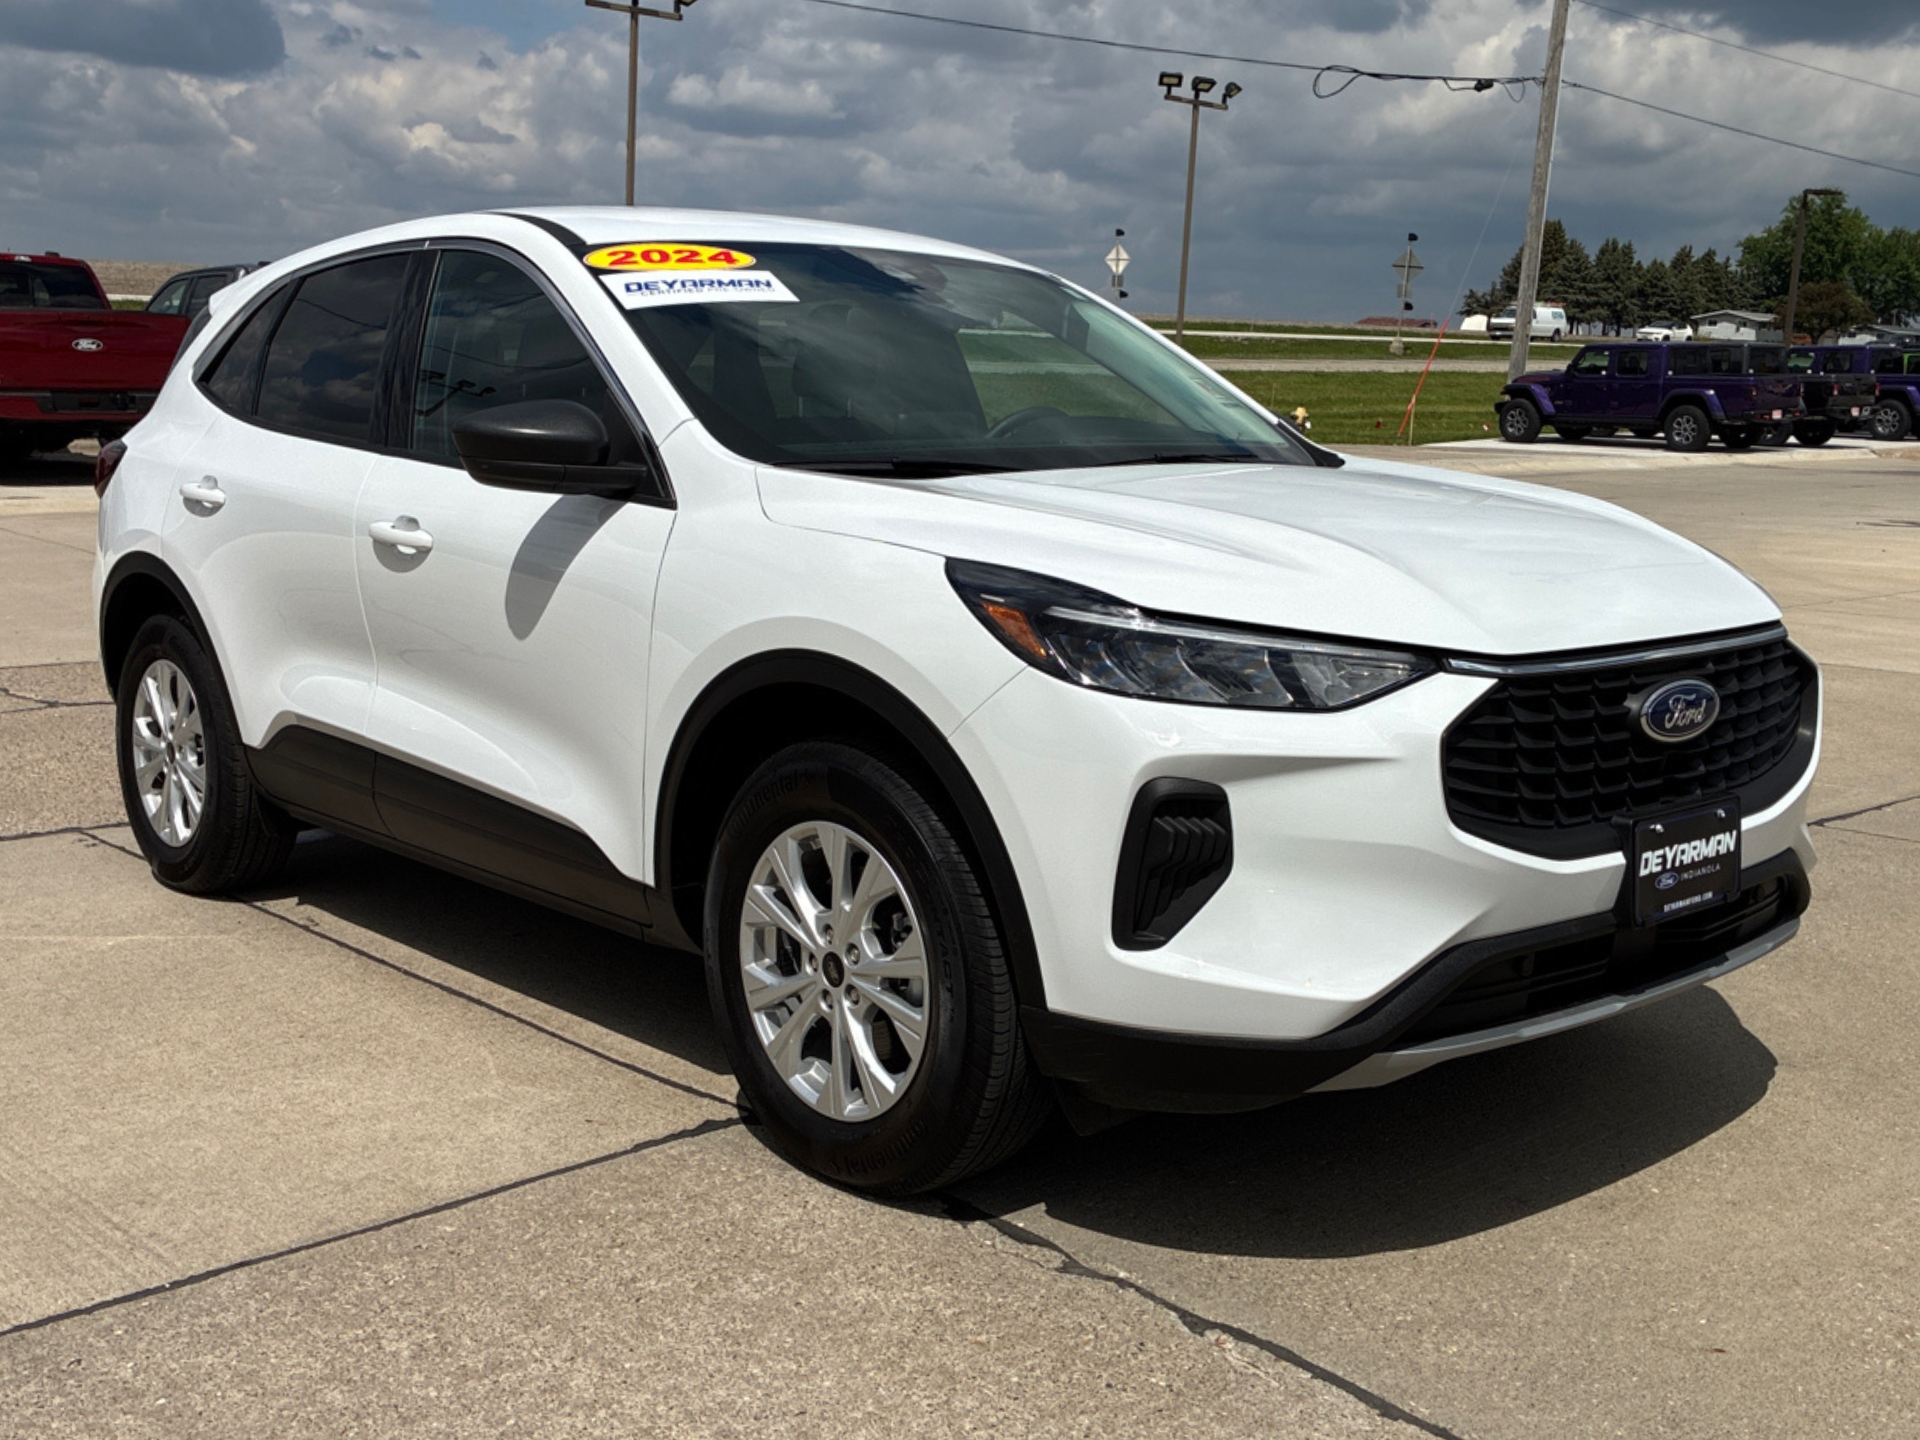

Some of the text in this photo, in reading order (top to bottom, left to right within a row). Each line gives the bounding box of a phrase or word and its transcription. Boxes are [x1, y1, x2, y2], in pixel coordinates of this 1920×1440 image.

[607, 249, 739, 266] 2024
[624, 279, 772, 293] DEYARMAN
[1664, 693, 1707, 729] Ford
[1639, 829, 1737, 877] DEYARMAN
[1680, 863, 1721, 881] INDIANOLA
